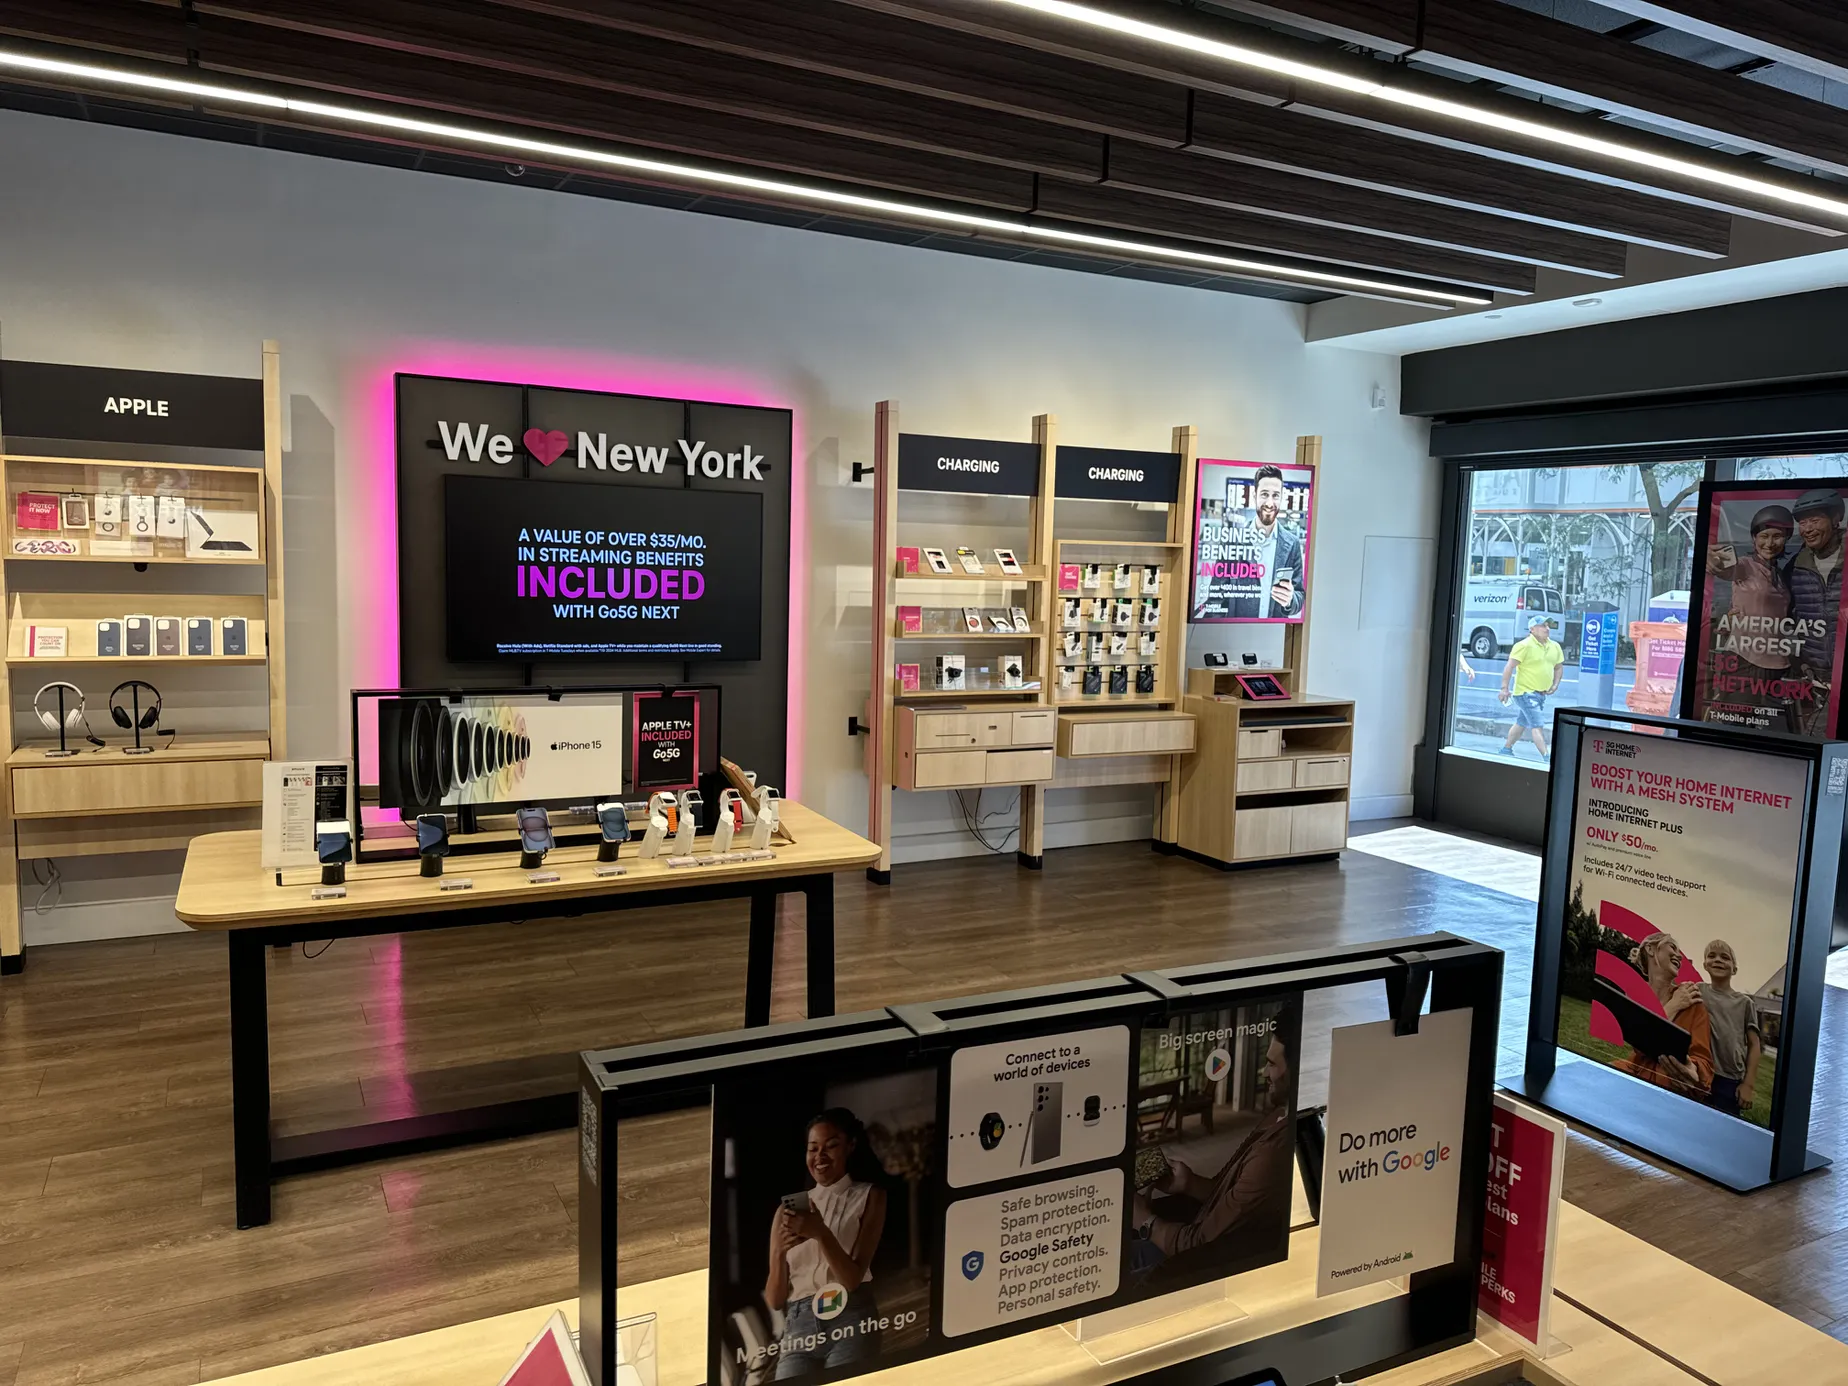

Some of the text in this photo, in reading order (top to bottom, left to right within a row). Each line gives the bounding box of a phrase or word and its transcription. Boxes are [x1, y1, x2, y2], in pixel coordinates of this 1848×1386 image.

[104, 397, 169, 417] APPLE
[438, 420, 764, 481] We New York
[937, 457, 1000, 474] CHARGING
[1088, 467, 1144, 482] CHARGING
[518, 528, 706, 548] A VALUE OF OVER $35/MO.
[1203, 526, 1266, 544] BUSINESS
[518, 547, 704, 566] IN STREAMING BENEFITS
[1202, 544, 1262, 560] BENEFITS
[1201, 562, 1265, 578] INCLUDED
[517, 565, 706, 600] INCLUDED
[1474, 594, 1507, 603] verizon
[553, 604, 680, 619] WITH Go5G NEXT
[1718, 614, 1827, 637] AMERICA'S
[1716, 634, 1806, 657] LARGEST
[1713, 654, 1738, 672] 5G
[1712, 674, 1814, 701] NETWORK
[1710, 711, 1769, 726] T-Mobile plans
[1711, 702, 1752, 713] INCLUDED
[1767, 708, 1778, 717] all
[641, 730, 692, 741] INCLUDED
[642, 720, 692, 731] APPLE TV+
[558, 740, 602, 750] iPhone 15
[653, 748, 680, 759] Go5G
[1605, 748, 1636, 758] INTERNET
[1616, 743, 1635, 752] HOME
[1591, 776, 1734, 814] WITH A MESH SYSTEM
[1592, 763, 1792, 809] BOOST YOUR HOME INTERNET
[1589, 799, 1649, 817] INTRODUCING
[1588, 808, 1683, 834] HOME INTERNET PLUS
[1587, 826, 1658, 852] ONLY $50/mo.
[1583, 865, 1688, 897] for Wi-Fi connected devices.
[1584, 855, 1706, 891] Includes 24/7 video tech support
[1159, 1018, 1277, 1050] Big screen magic
[1006, 1046, 1081, 1066] Connect to a
[993, 1057, 1091, 1082] world of devices
[1339, 1124, 1417, 1154] Do more
[1338, 1141, 1450, 1184] with Google
[1001, 1183, 1099, 1214] Safe browsing.
[1001, 1197, 1114, 1232] Spam protection.
[1001, 1213, 1110, 1247] Data encryption.
[1000, 1233, 1094, 1264] Google Safety
[999, 1246, 1108, 1281] Privacy controls.
[1331, 1253, 1402, 1279] Powered by Android
[998, 1264, 1102, 1298] App protection.
[1481, 1274, 1516, 1304] PERKS
[998, 1278, 1100, 1314] Personal safety.
[736, 1310, 916, 1364] Meetings on the go
